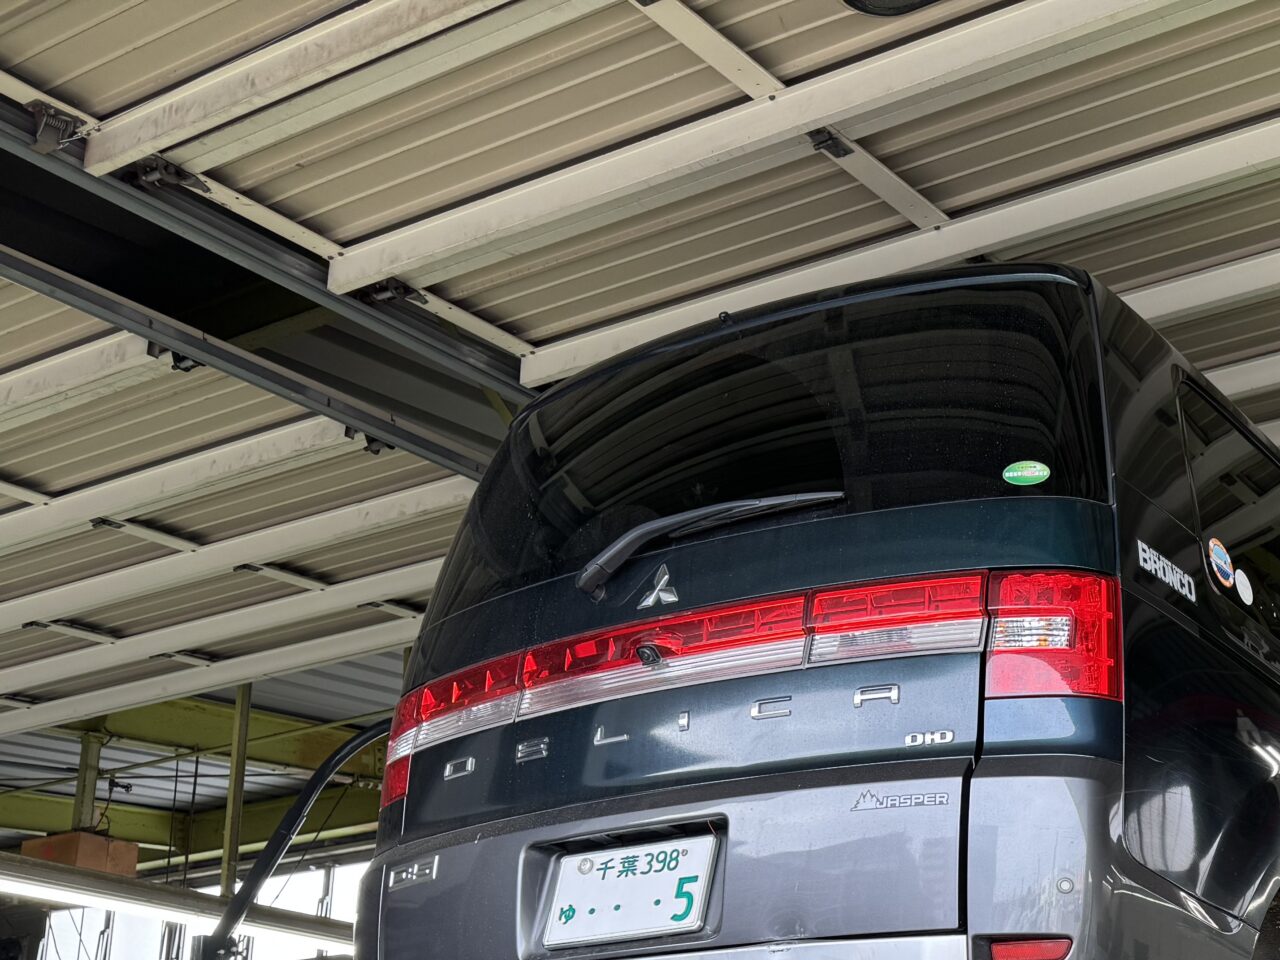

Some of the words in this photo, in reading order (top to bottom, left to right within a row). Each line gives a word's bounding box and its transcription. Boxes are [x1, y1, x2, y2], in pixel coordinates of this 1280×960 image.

[1137, 539, 1197, 603] BRONCO
[443, 683, 901, 781] DELICA
[875, 791, 950, 810] JASPER
[558, 903, 576, 925] ゆ
